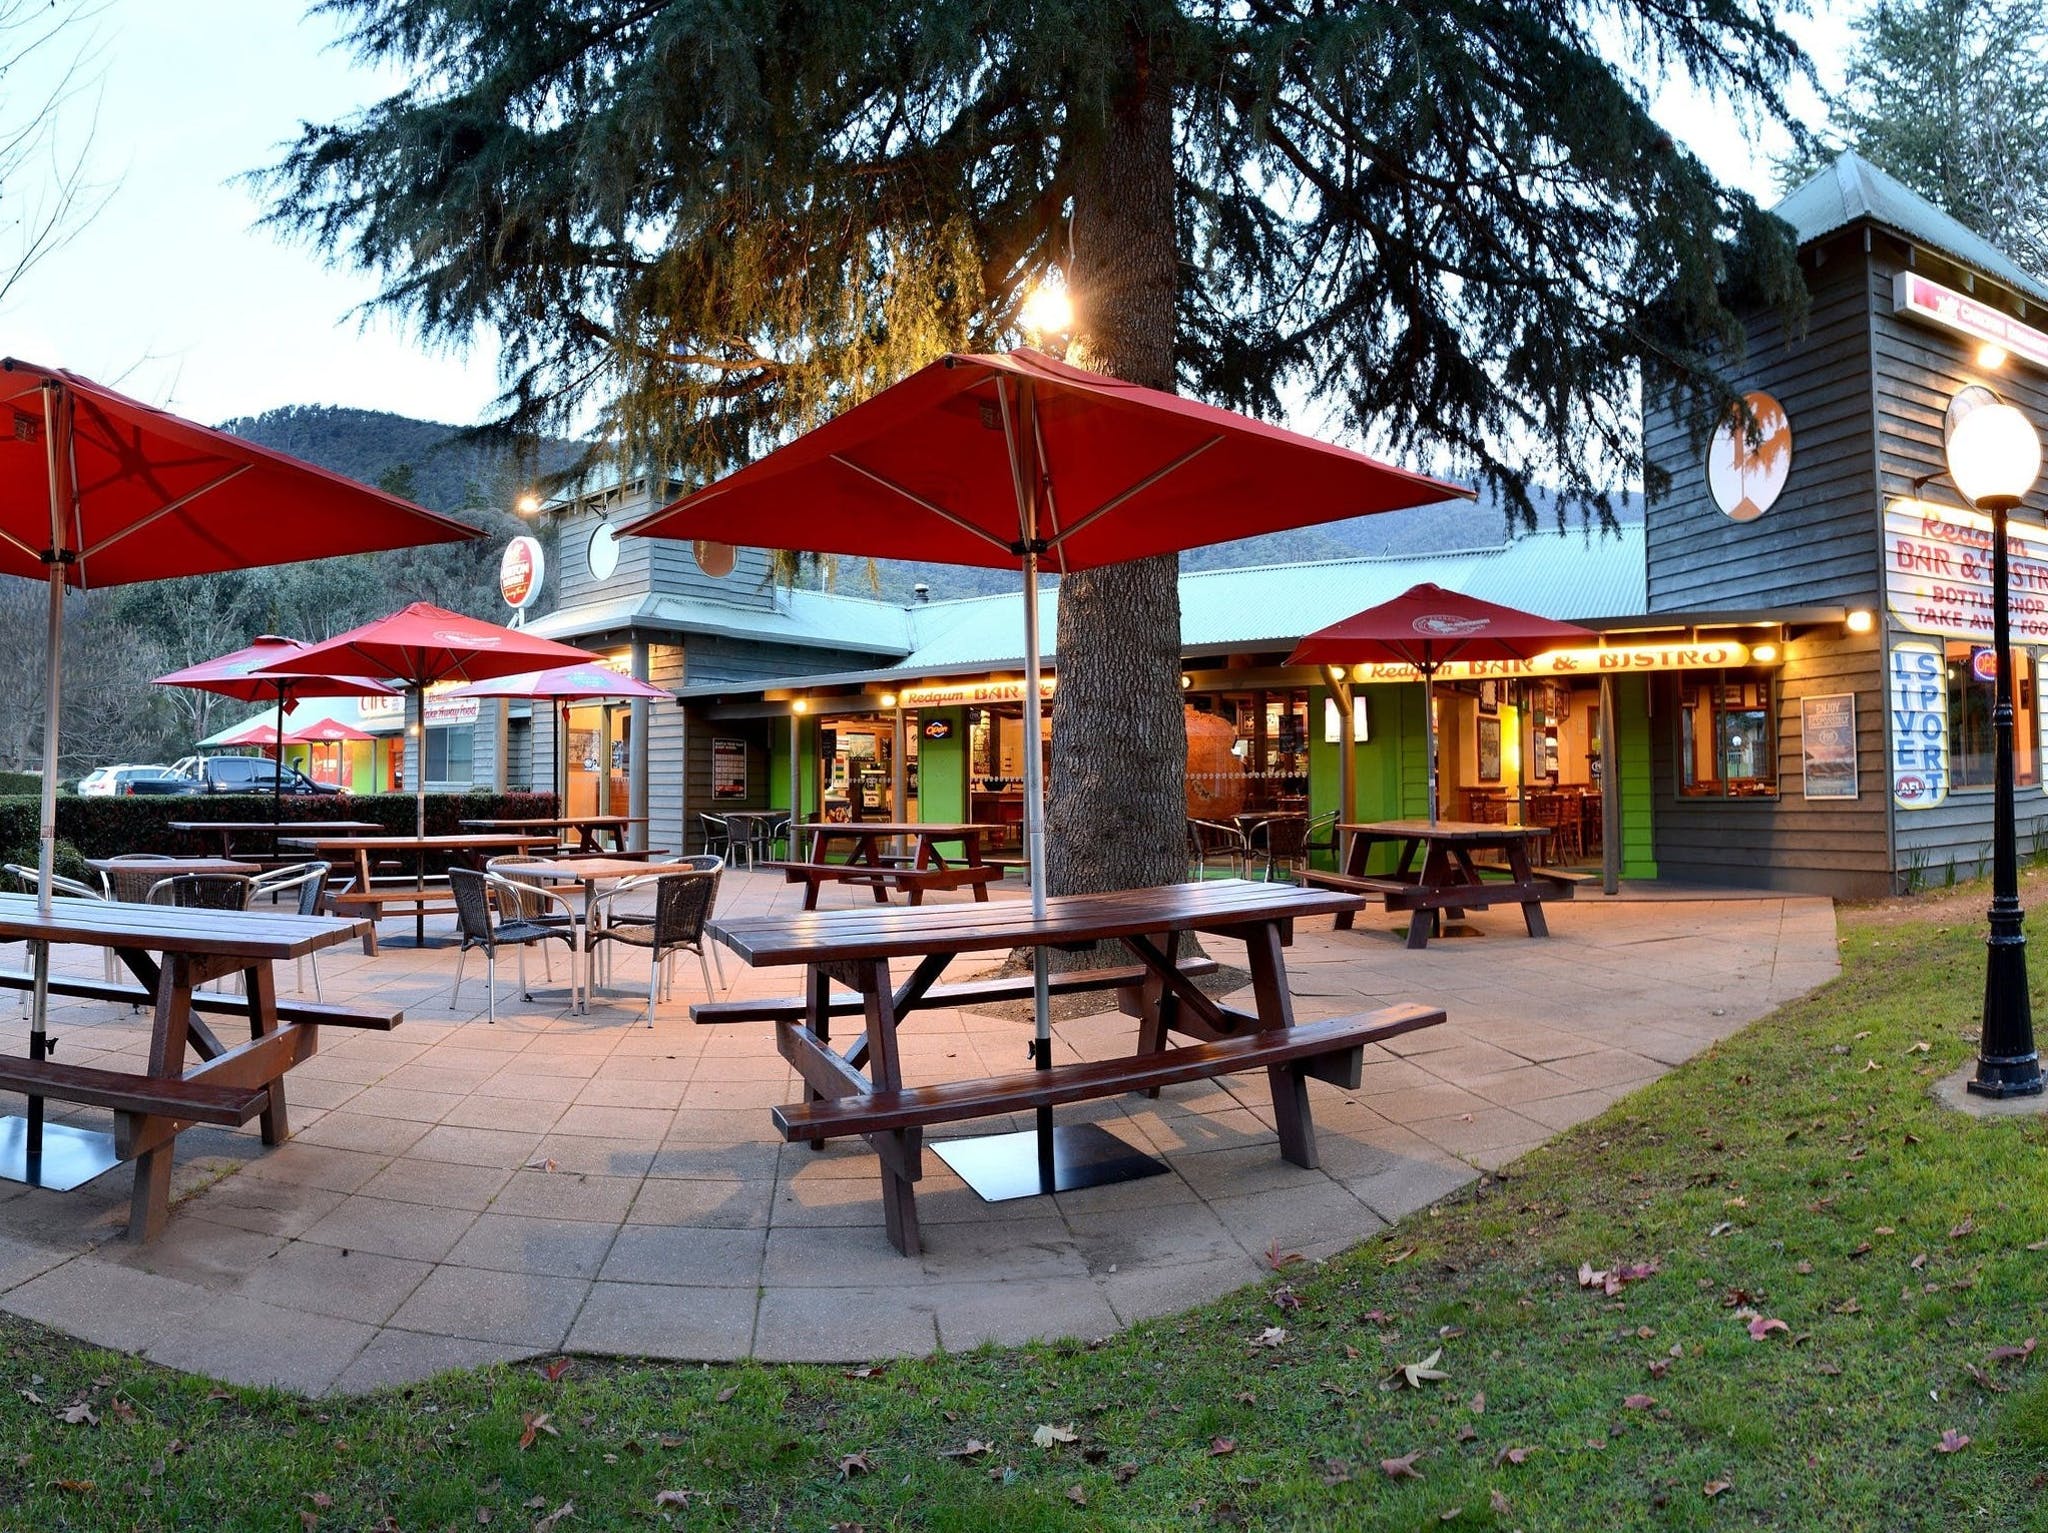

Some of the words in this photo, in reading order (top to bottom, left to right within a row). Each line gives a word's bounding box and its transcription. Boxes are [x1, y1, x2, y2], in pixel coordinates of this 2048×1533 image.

[1921, 511, 2028, 562] Redgm
[1897, 540, 1951, 575] BAR
[1961, 552, 1981, 580] &
[1988, 558, 2048, 590] STR
[1915, 606, 1962, 628] TAKE
[1969, 614, 2014, 632] AWY
[2021, 620, 2048, 636] FOO
[1371, 663, 1452, 682] Redgm
[1469, 659, 1533, 676] BAR
[1552, 656, 1578, 671] &
[1599, 649, 1727, 669] BISTRO
[1977, 654, 1996, 673] OPE
[908, 691, 964, 707] Redgum
[974, 685, 1019, 700] BAR
[1815, 701, 1840, 715] ENJOY
[1894, 653, 1916, 765] LIVE
[926, 725, 949, 736] Open
[1917, 654, 1943, 800] SPORT
[1901, 781, 1920, 793] AFL
